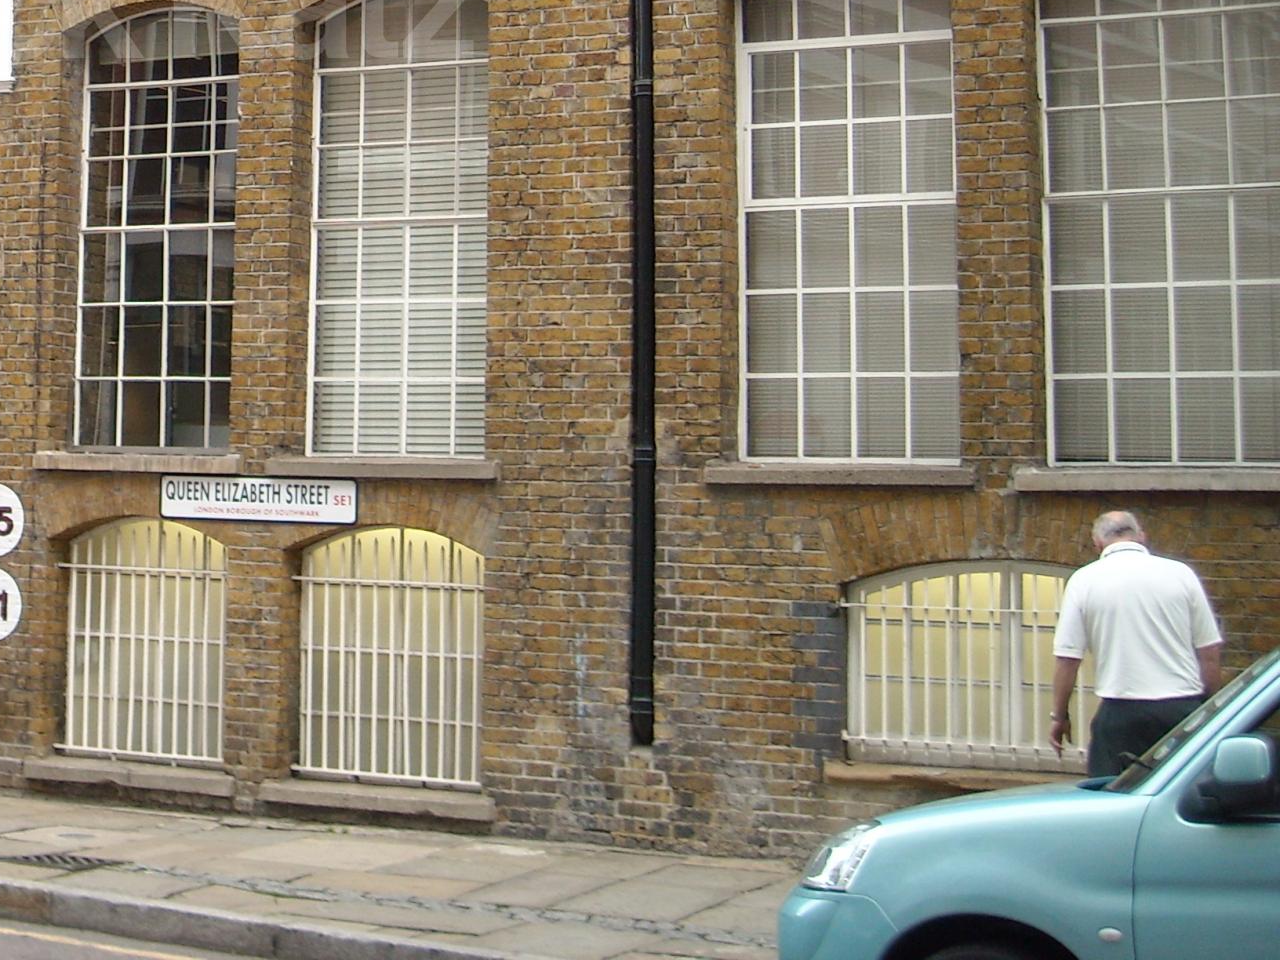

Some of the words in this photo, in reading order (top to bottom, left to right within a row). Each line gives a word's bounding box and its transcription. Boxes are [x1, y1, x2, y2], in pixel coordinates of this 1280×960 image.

[165, 480, 211, 502] QUEEN
[214, 482, 282, 504] ELIZABETH
[285, 483, 331, 506] STREET
[333, 495, 352, 507] SE1
[193, 506, 225, 514] LONDON
[226, 507, 262, 515] BOROUGH
[274, 509, 320, 517] SOUTHWARK
